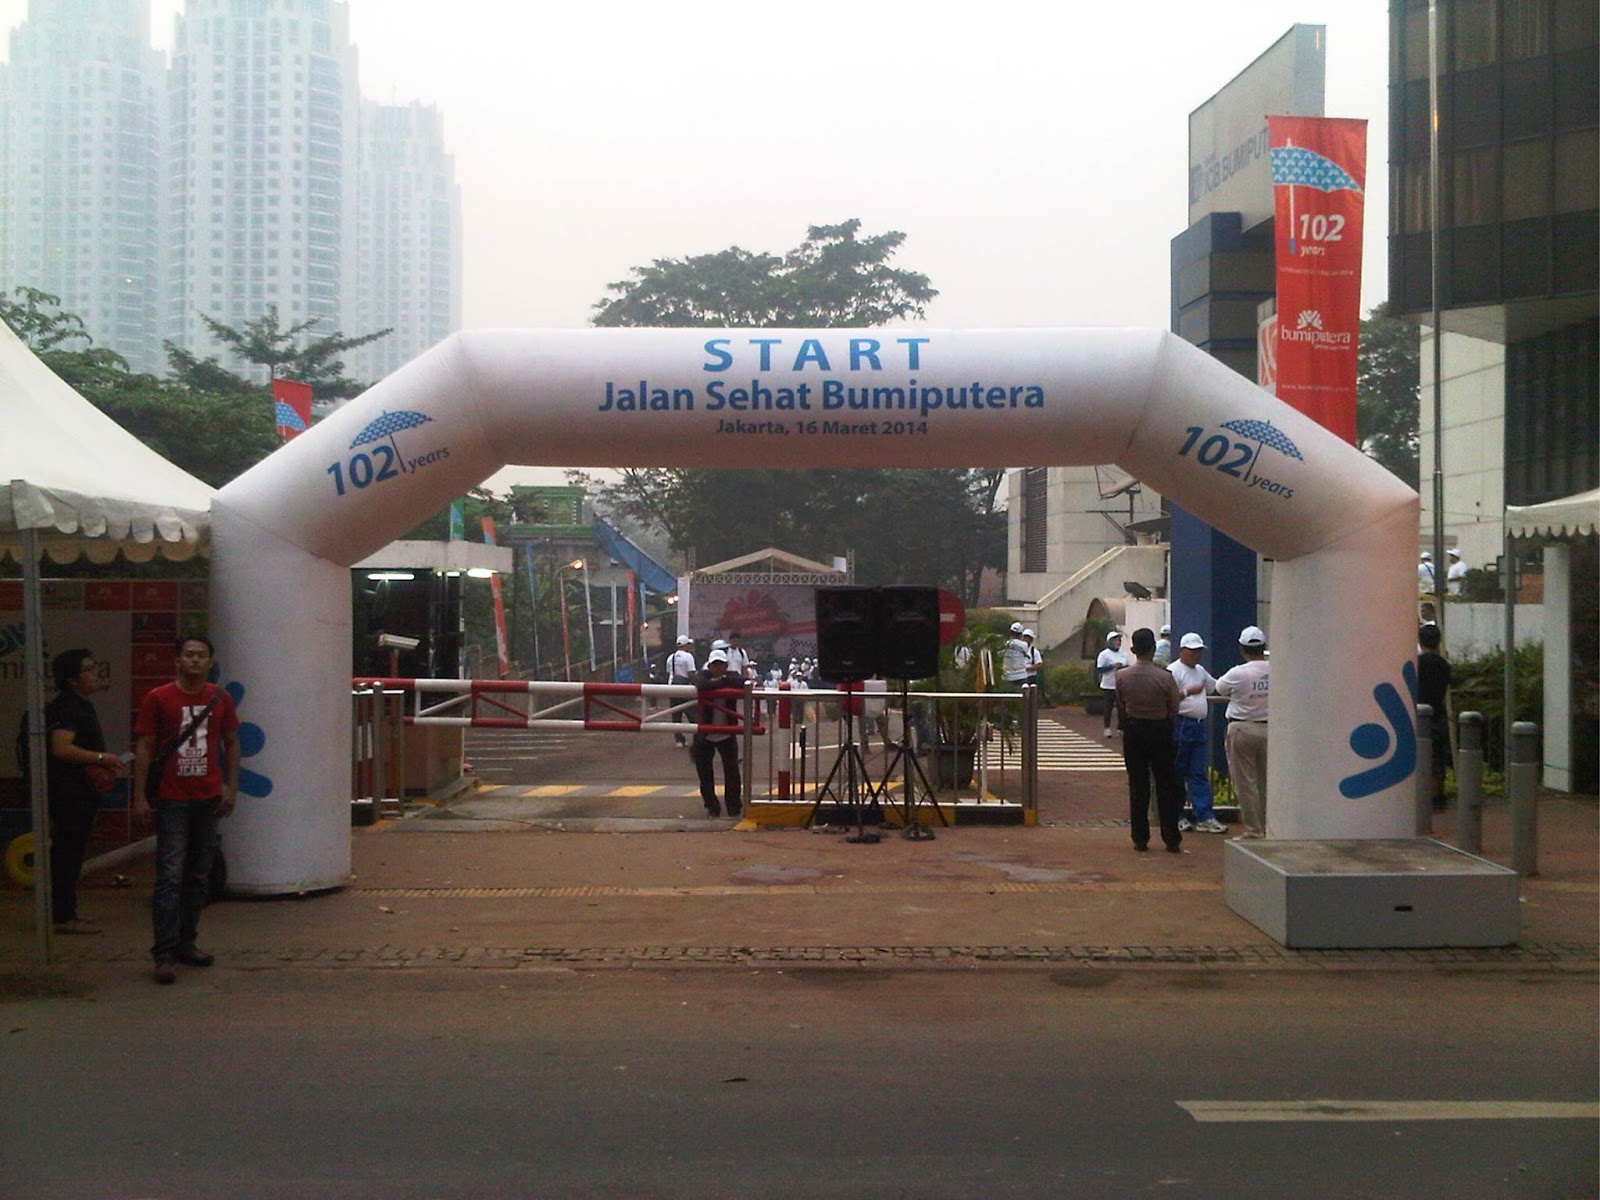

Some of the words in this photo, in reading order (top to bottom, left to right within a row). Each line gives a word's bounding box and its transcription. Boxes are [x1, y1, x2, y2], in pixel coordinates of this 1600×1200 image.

[1300, 213, 1345, 241] 102
[1300, 246, 1326, 257] years
[1281, 325, 1350, 344] bumiputera
[703, 338, 930, 372] START
[599, 380, 694, 411] Jalan
[705, 379, 811, 411] Sehat
[822, 379, 1044, 417] Bumiputera
[716, 419, 790, 436] Jakarta,
[797, 421, 817, 435] 16
[822, 420, 877, 435] Maret
[882, 421, 928, 435] 2014
[327, 445, 398, 496] 102
[408, 447, 450, 474] years
[1178, 426, 1253, 478] 102
[1248, 475, 1294, 499] years
